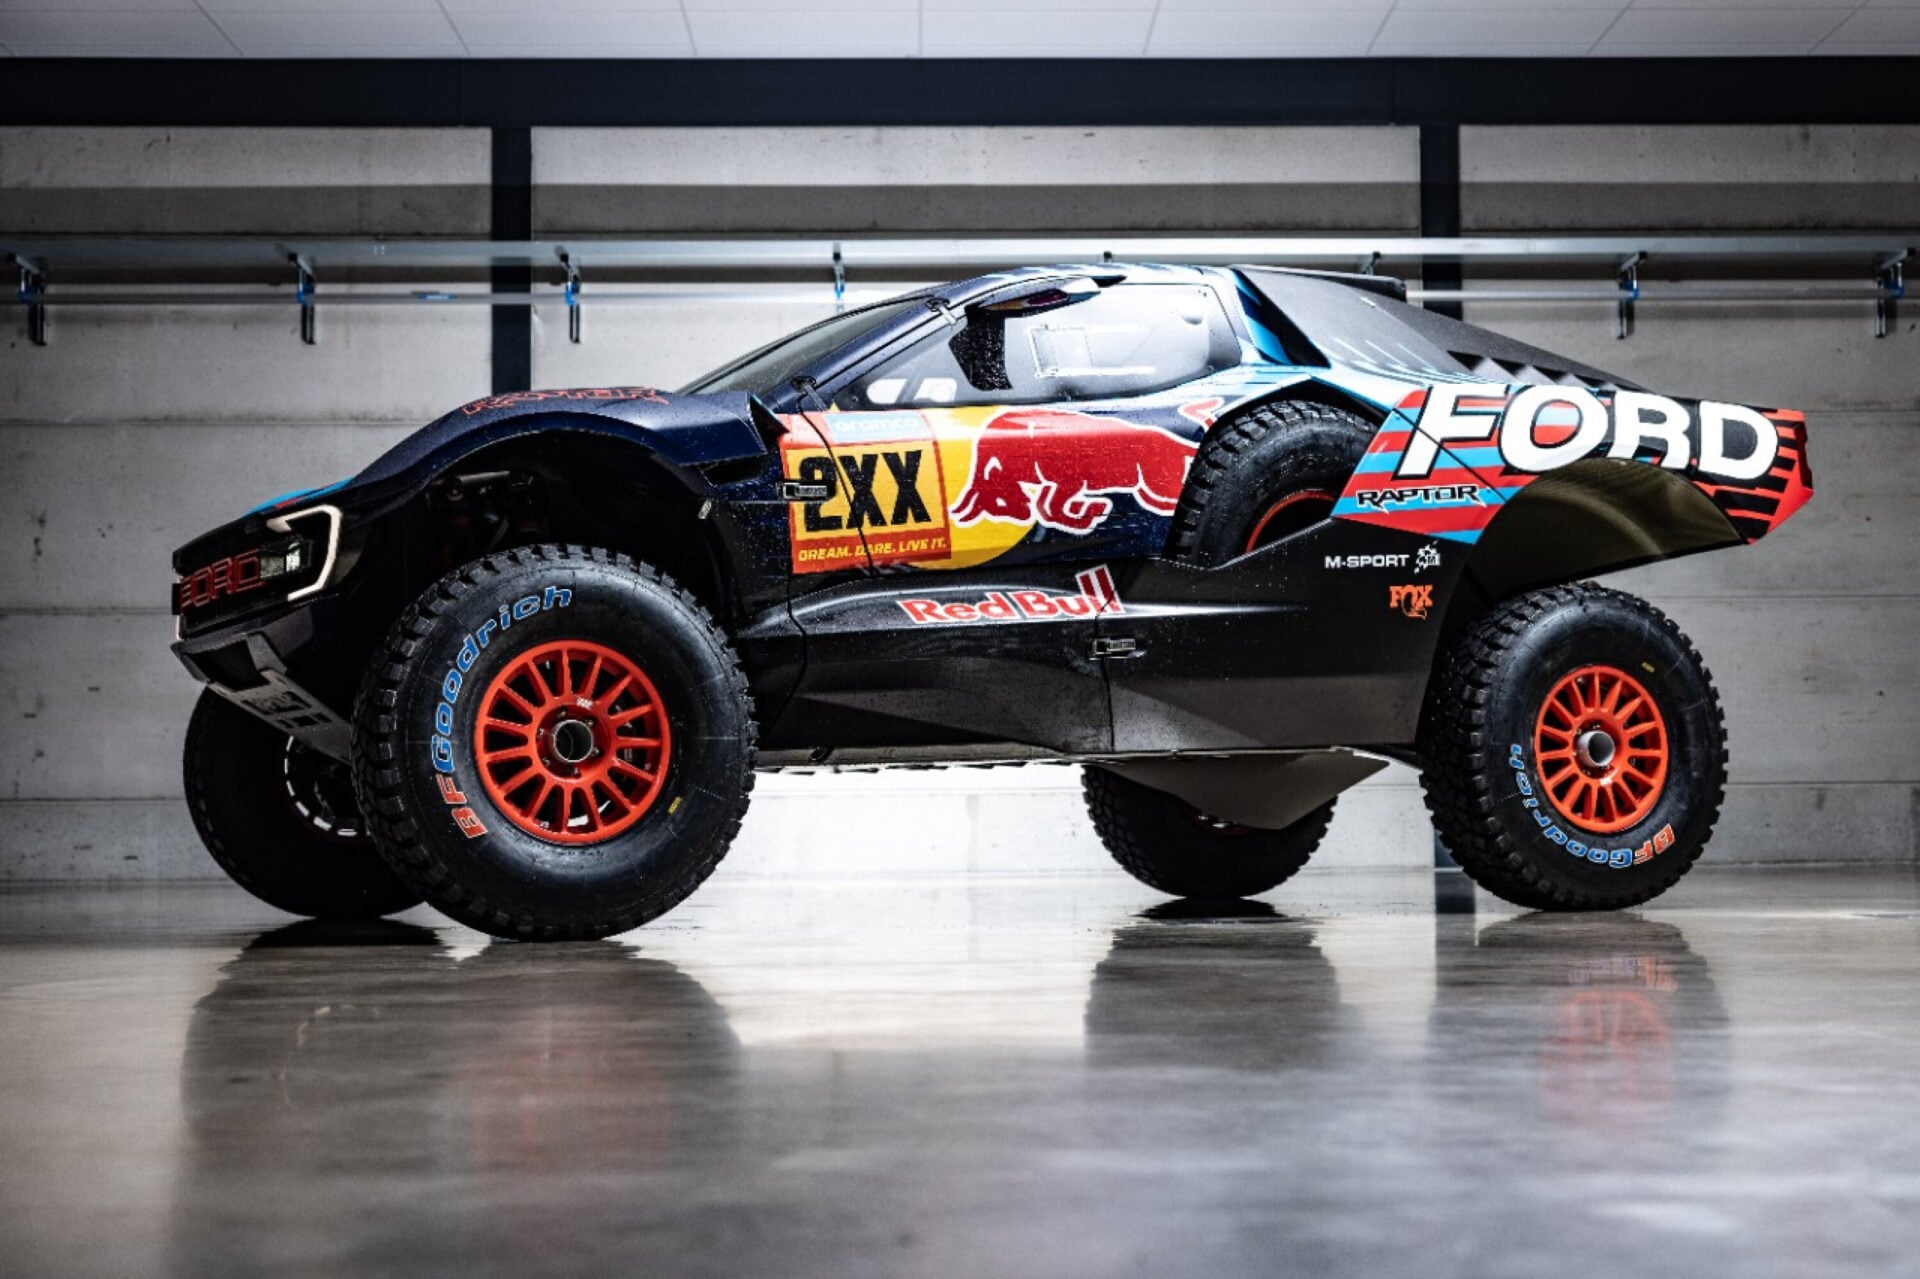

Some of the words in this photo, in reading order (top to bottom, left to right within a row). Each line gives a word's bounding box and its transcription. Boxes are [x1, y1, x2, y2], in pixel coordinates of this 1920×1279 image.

[1393, 383, 1779, 480] FORD
[799, 450, 931, 532] 2XX
[1356, 484, 1487, 514] RAPTOR
[798, 545, 852, 561] DREAM.
[899, 539, 928, 552] LIVE
[898, 591, 1021, 623] Red
[1009, 564, 1126, 618] Bull
[1389, 584, 1433, 615] FOX
